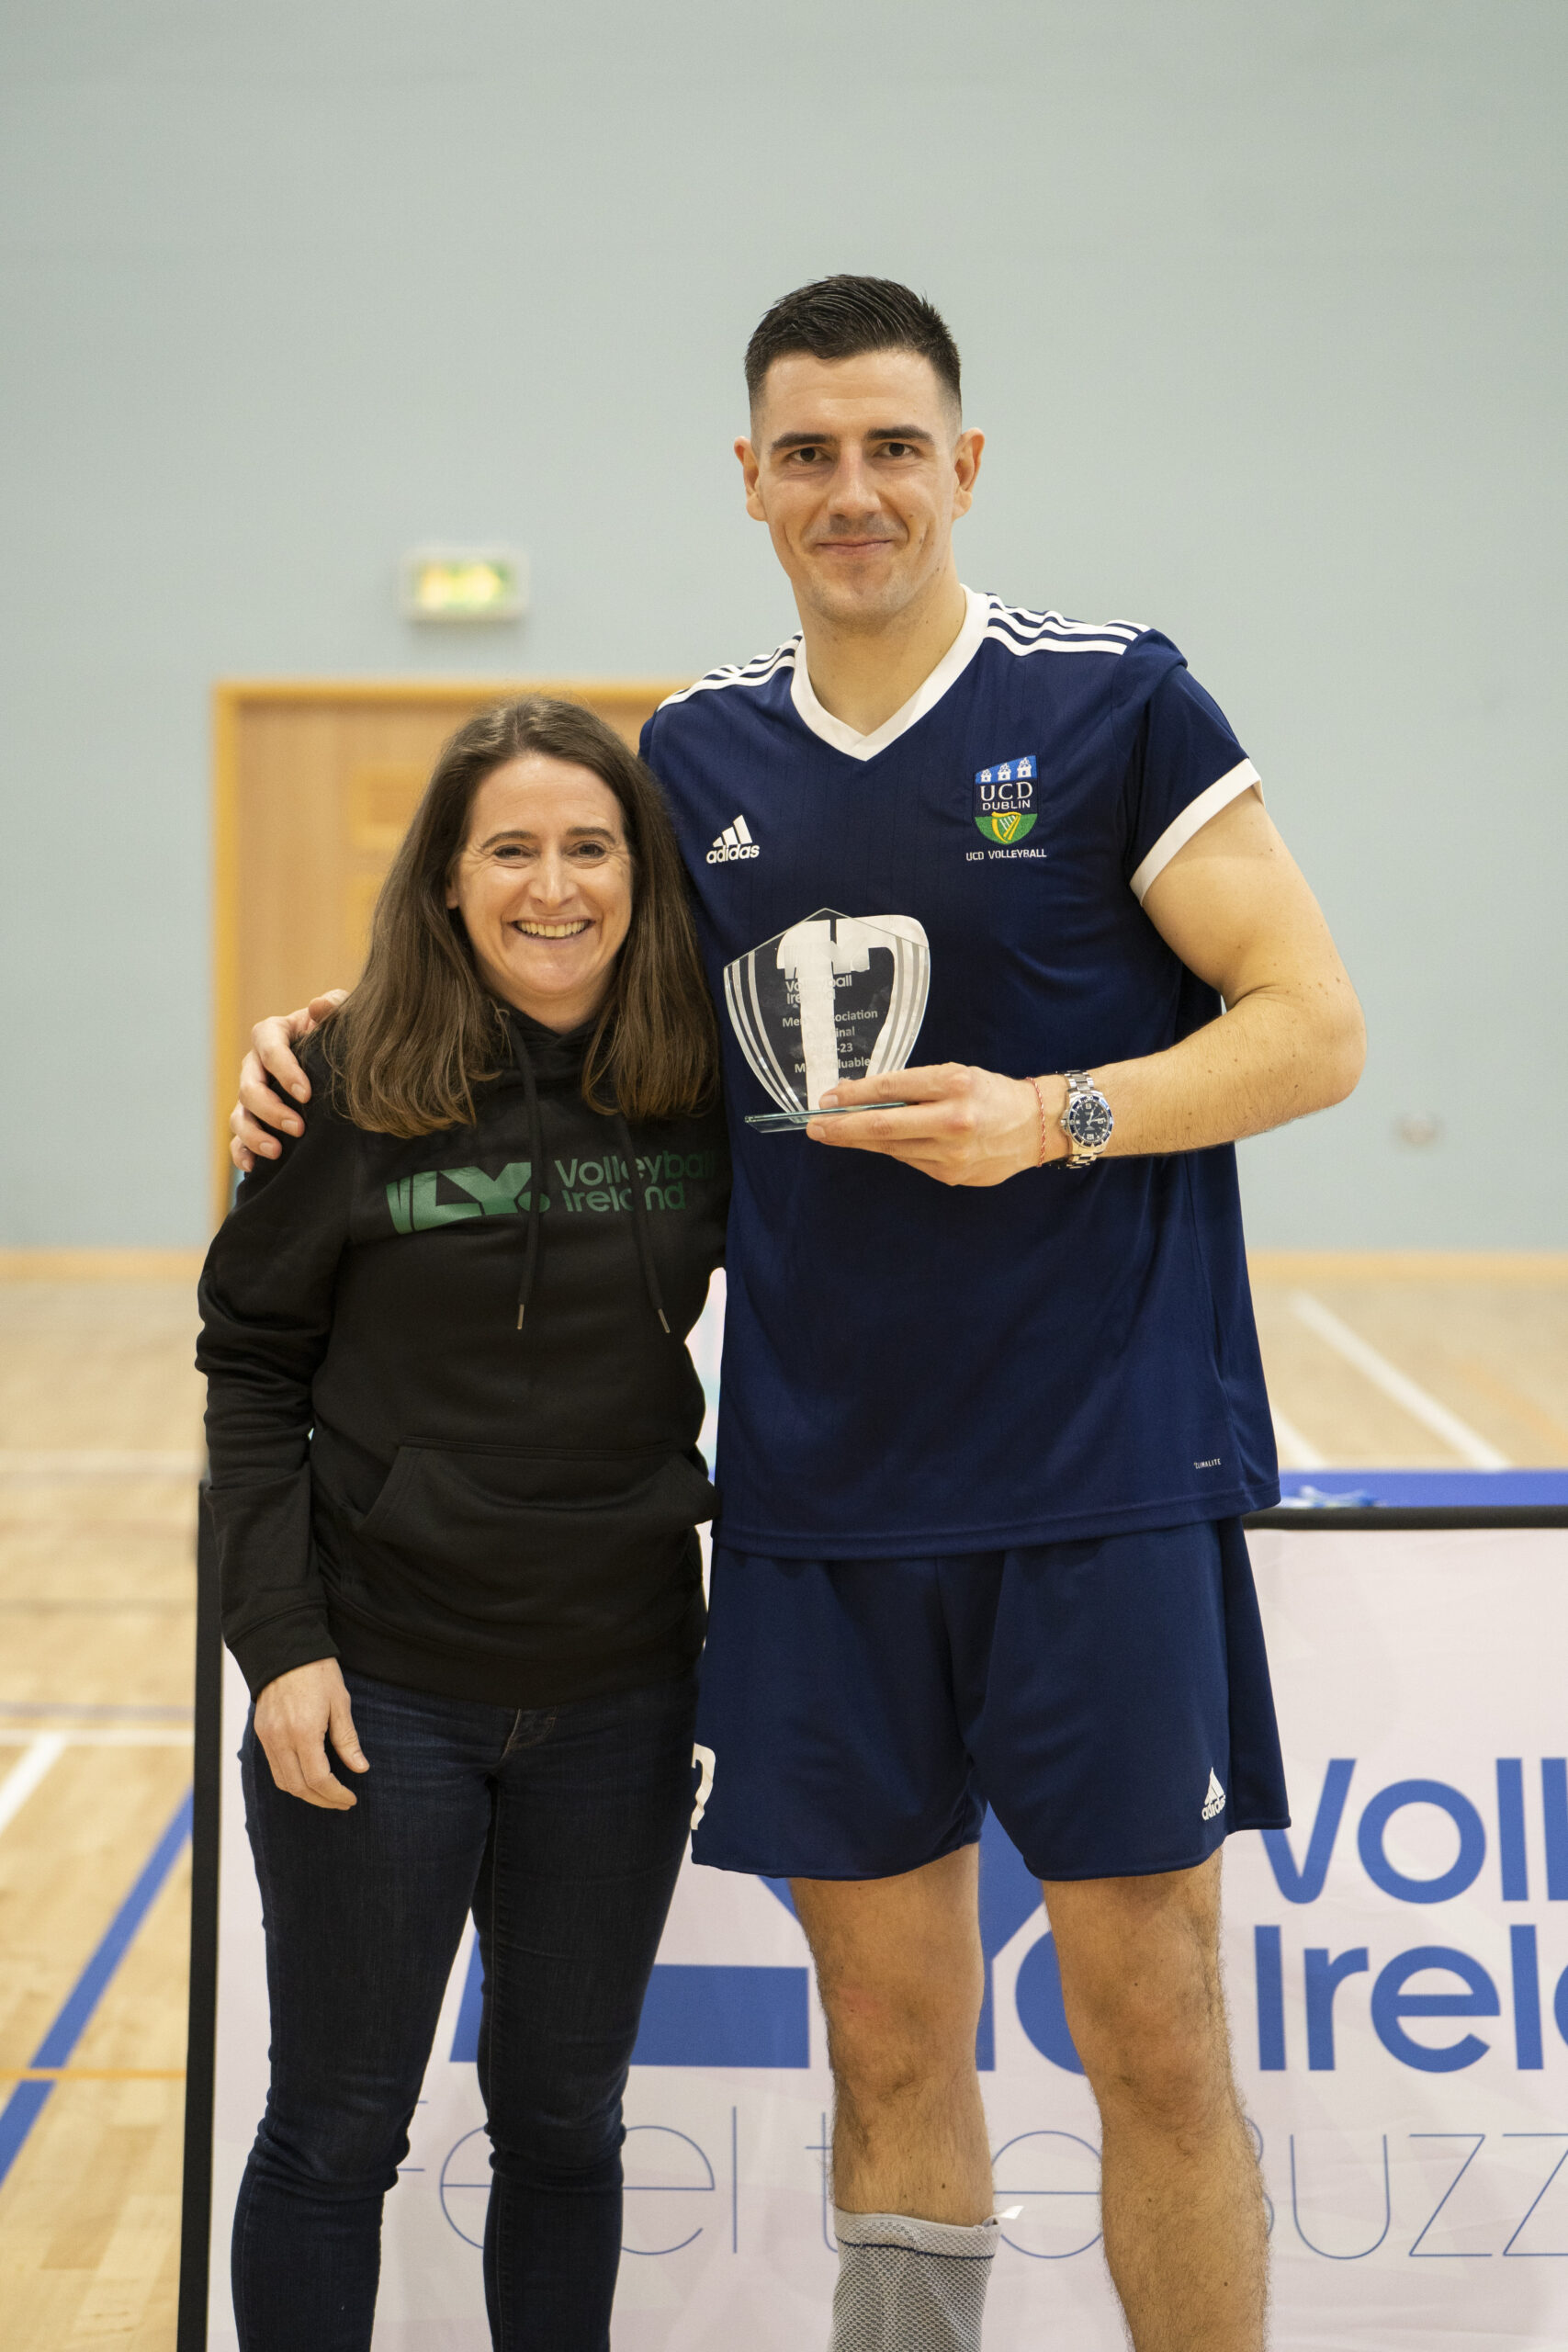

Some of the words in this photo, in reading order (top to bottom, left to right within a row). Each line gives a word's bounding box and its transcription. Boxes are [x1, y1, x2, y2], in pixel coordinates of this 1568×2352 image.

[980, 781, 1032, 801] UCD
[982, 799, 1031, 810] DUBLIN
[705, 844, 760, 864] adidas
[965, 851, 985, 862] UCD
[1254, 1924, 1568, 2074] Irel
